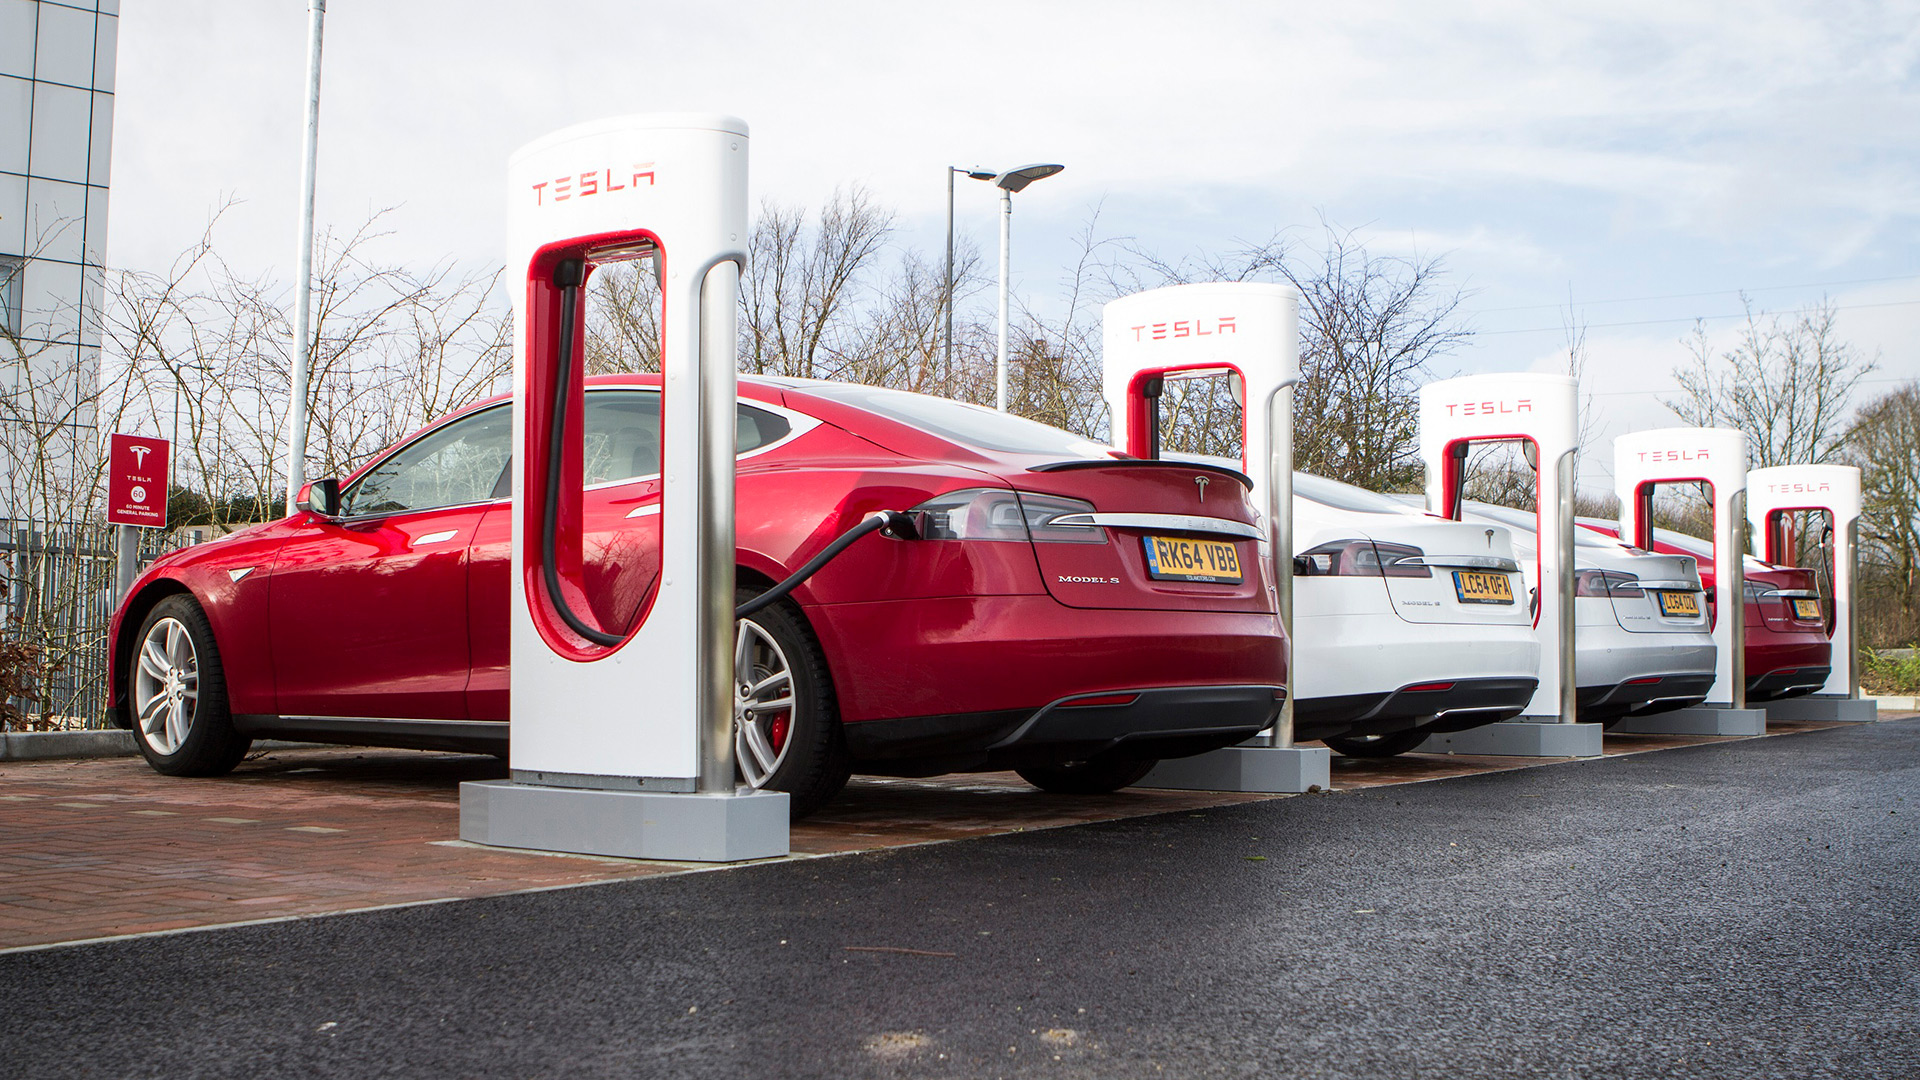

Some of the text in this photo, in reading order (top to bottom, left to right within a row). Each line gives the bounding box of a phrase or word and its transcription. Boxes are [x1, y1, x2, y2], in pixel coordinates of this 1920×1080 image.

[532, 162, 655, 206] TESLA
[1131, 317, 1236, 342] TESLA
[1445, 400, 1531, 417] TESLA
[1637, 449, 1709, 463] TESLA
[126, 475, 152, 483] TESLA
[133, 490, 144, 498] 60
[1768, 483, 1830, 494] TESLA
[116, 508, 159, 518] GENERAL PARKING
[1157, 540, 1238, 573] RK64 VBB
[1058, 575, 1108, 584] MODEL
[1461, 573, 1511, 596] LC64 OFA
[1664, 594, 1684, 610] LC64
